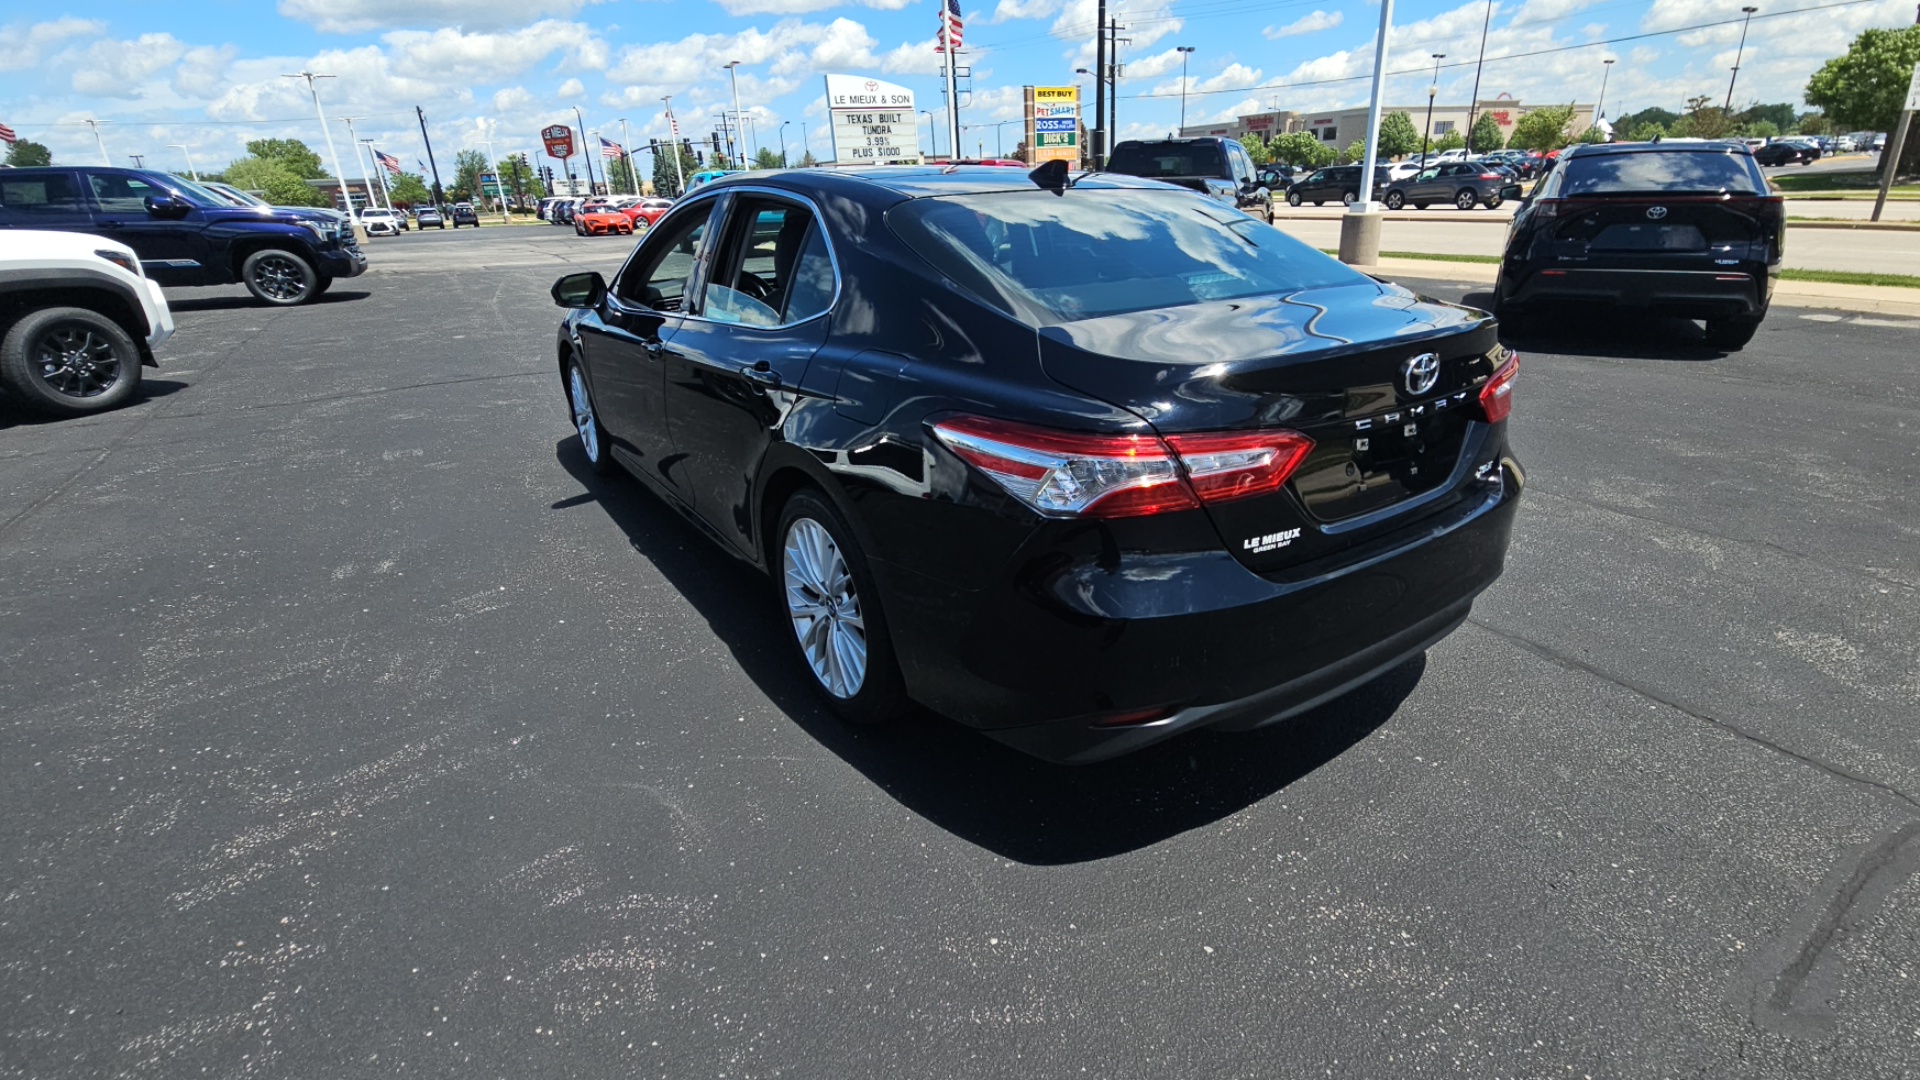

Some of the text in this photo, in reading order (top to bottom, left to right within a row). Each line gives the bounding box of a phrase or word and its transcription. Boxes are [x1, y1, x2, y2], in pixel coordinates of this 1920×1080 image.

[834, 95, 910, 104] LE MIEUX & SON
[846, 113, 901, 124] TEXAS BUILT
[862, 125, 892, 135] TUNDRA
[1036, 120, 1059, 129] ROSS
[543, 130, 551, 139] LE
[1043, 132, 1069, 144] DICK'S
[866, 136, 890, 146] 3.99%
[852, 147, 900, 158] PLUS $1000
[1355, 392, 1467, 431] CAMRY
[1243, 527, 1301, 549] LE MIEUX
[1253, 540, 1292, 553] GREEN BAY
